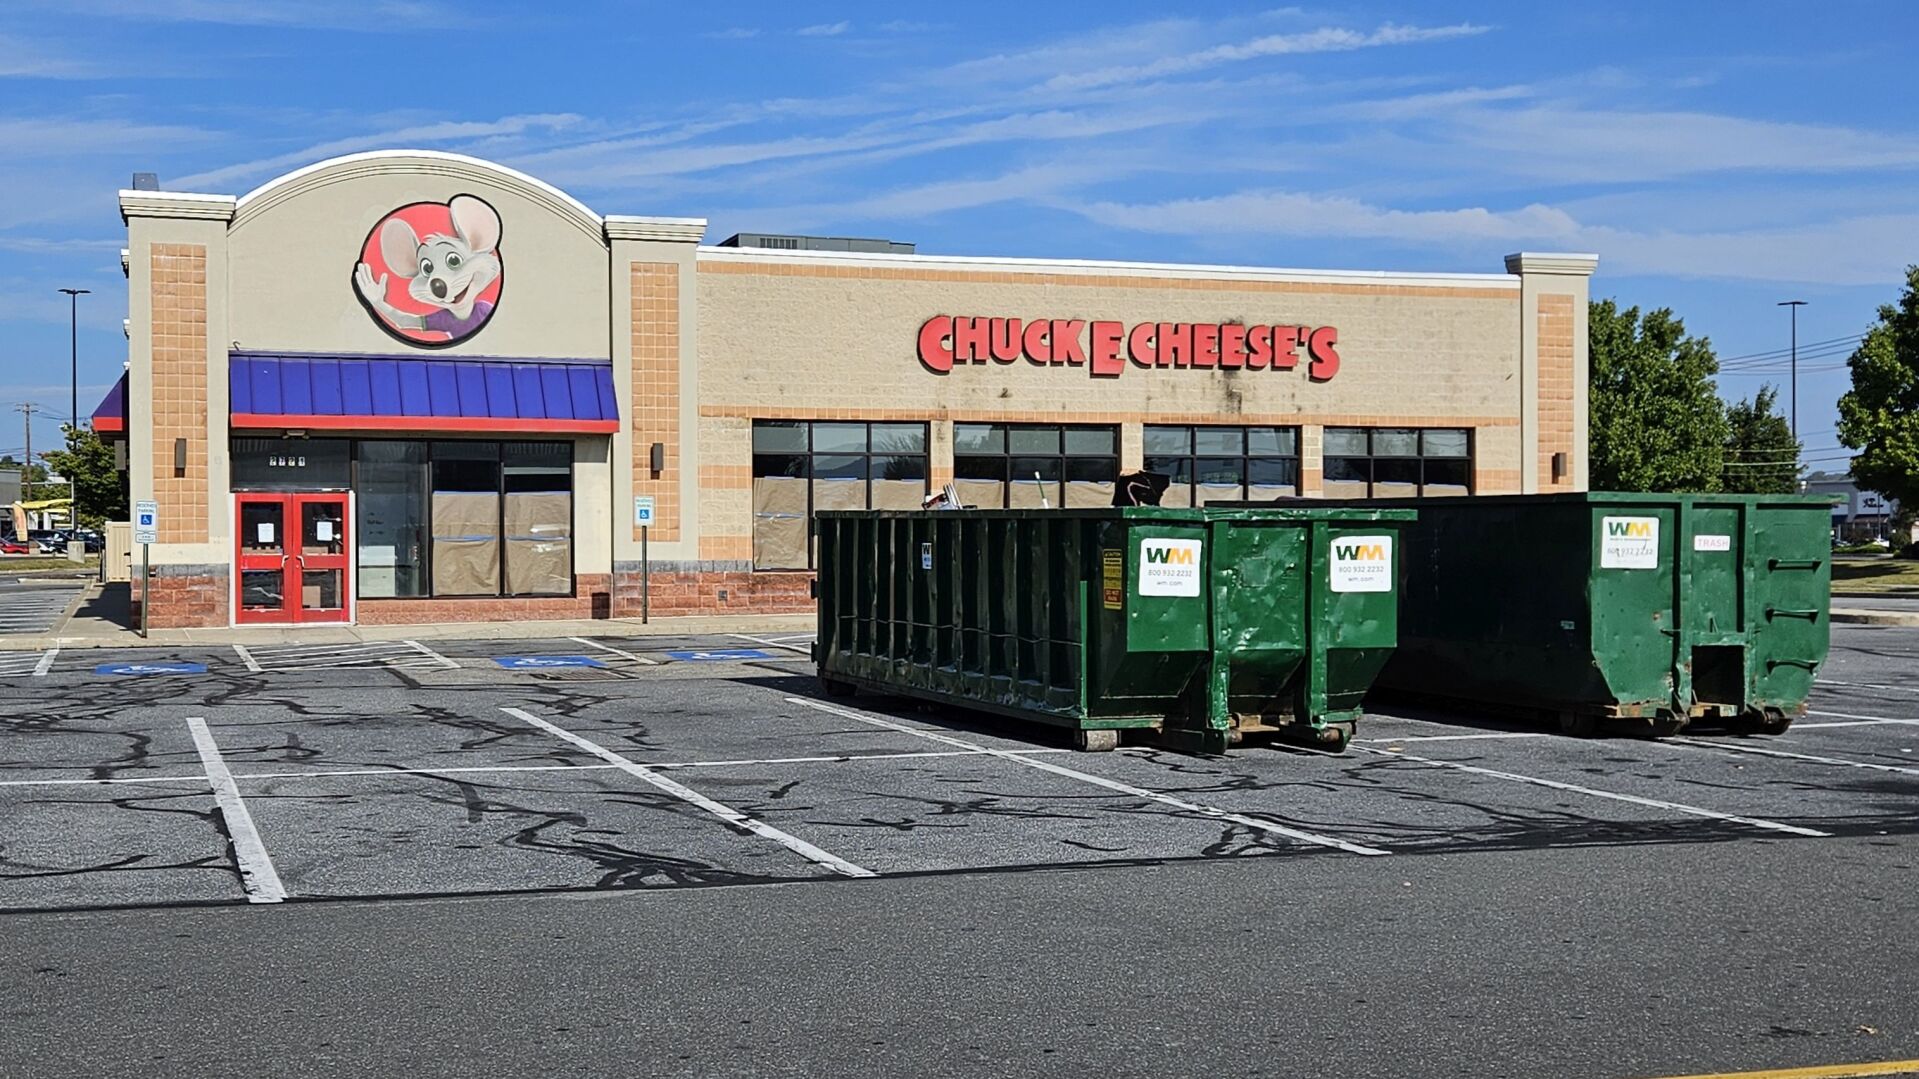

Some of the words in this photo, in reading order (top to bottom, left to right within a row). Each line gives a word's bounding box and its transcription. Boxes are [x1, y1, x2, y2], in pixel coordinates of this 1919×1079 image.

[918, 315, 1086, 374] CHUCK
[1090, 320, 1126, 378] E
[1127, 322, 1340, 382] CHEESE'S
[1697, 538, 1729, 547] TRASH
[1146, 547, 1194, 565] WM
[1335, 544, 1385, 561] WM
